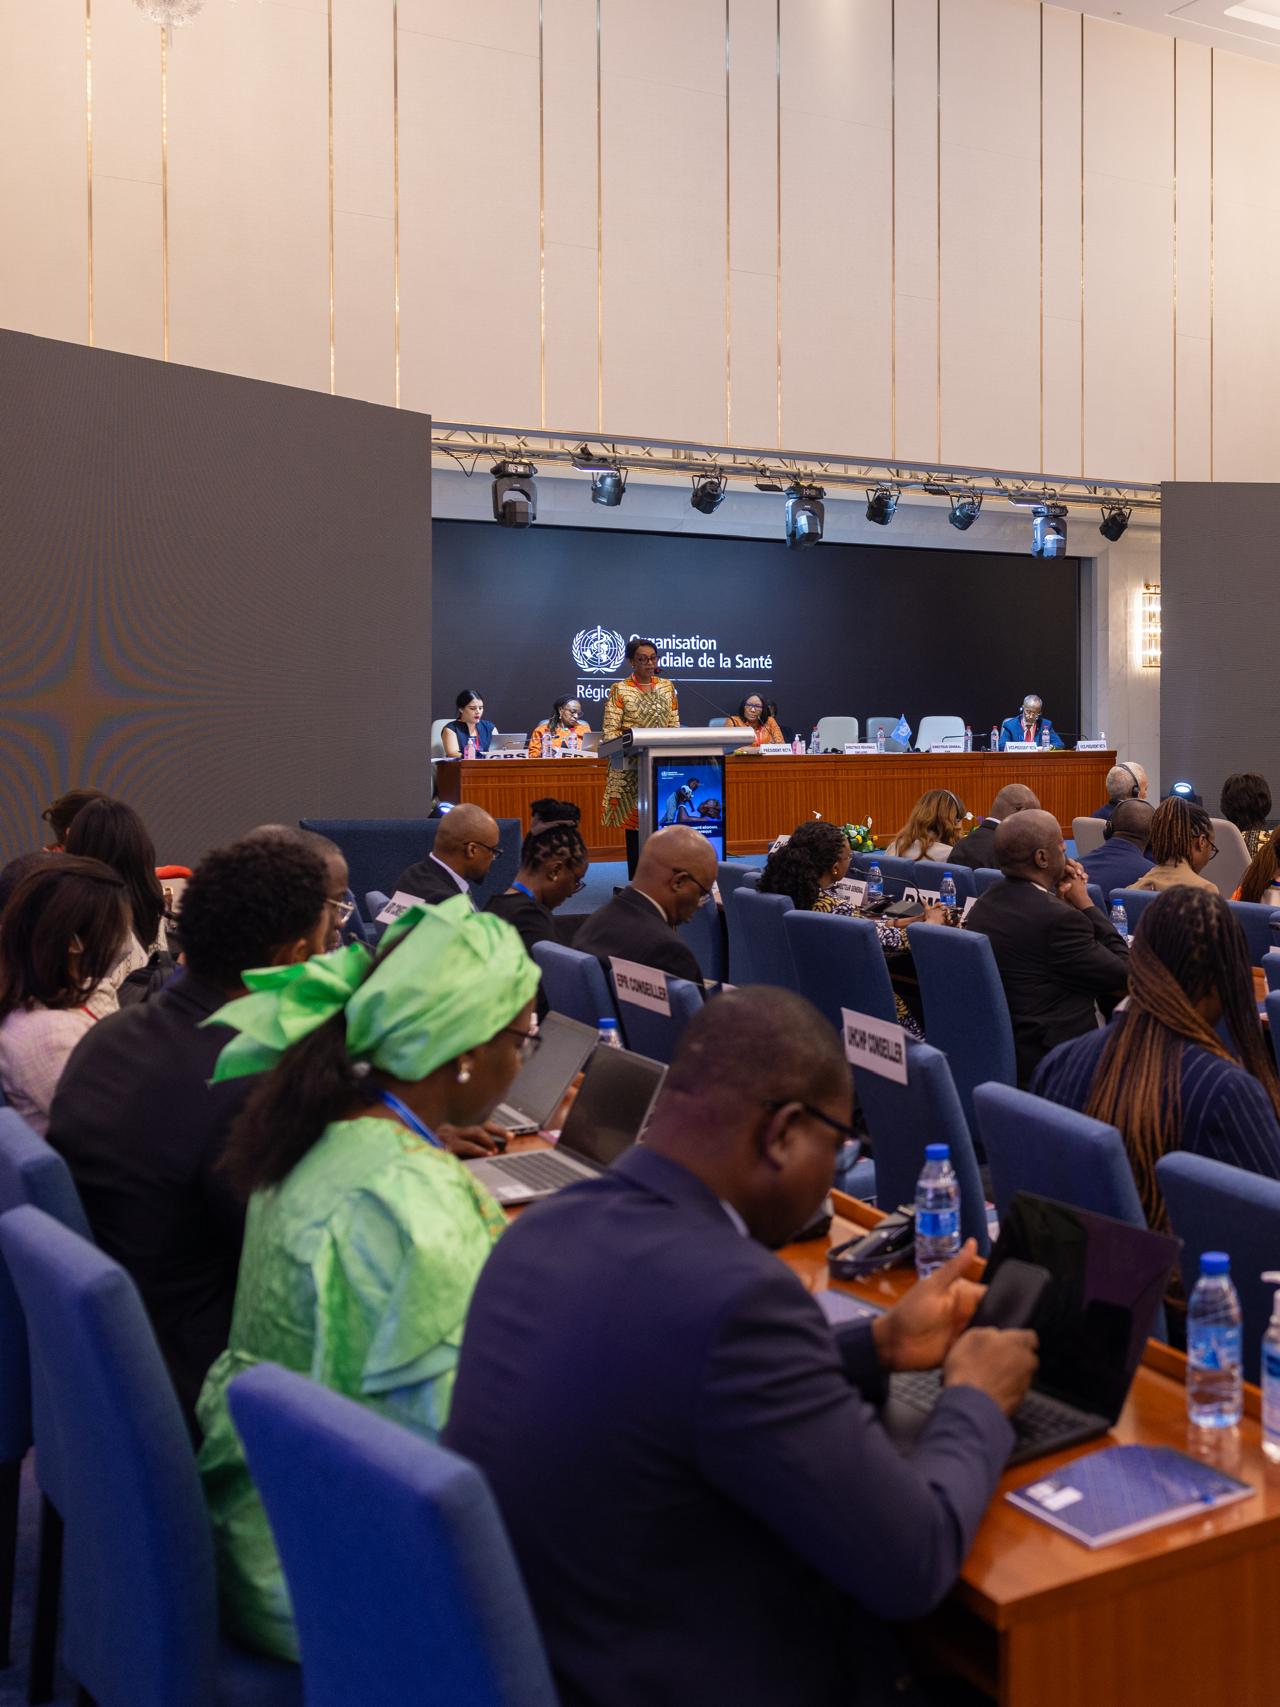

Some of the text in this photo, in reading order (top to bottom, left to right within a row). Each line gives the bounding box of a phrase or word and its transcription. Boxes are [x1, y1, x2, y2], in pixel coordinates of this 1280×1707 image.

[629, 633, 717, 650] anisation
[657, 652, 773, 669] diale de la Santé
[576, 684, 611, 702] Régio
